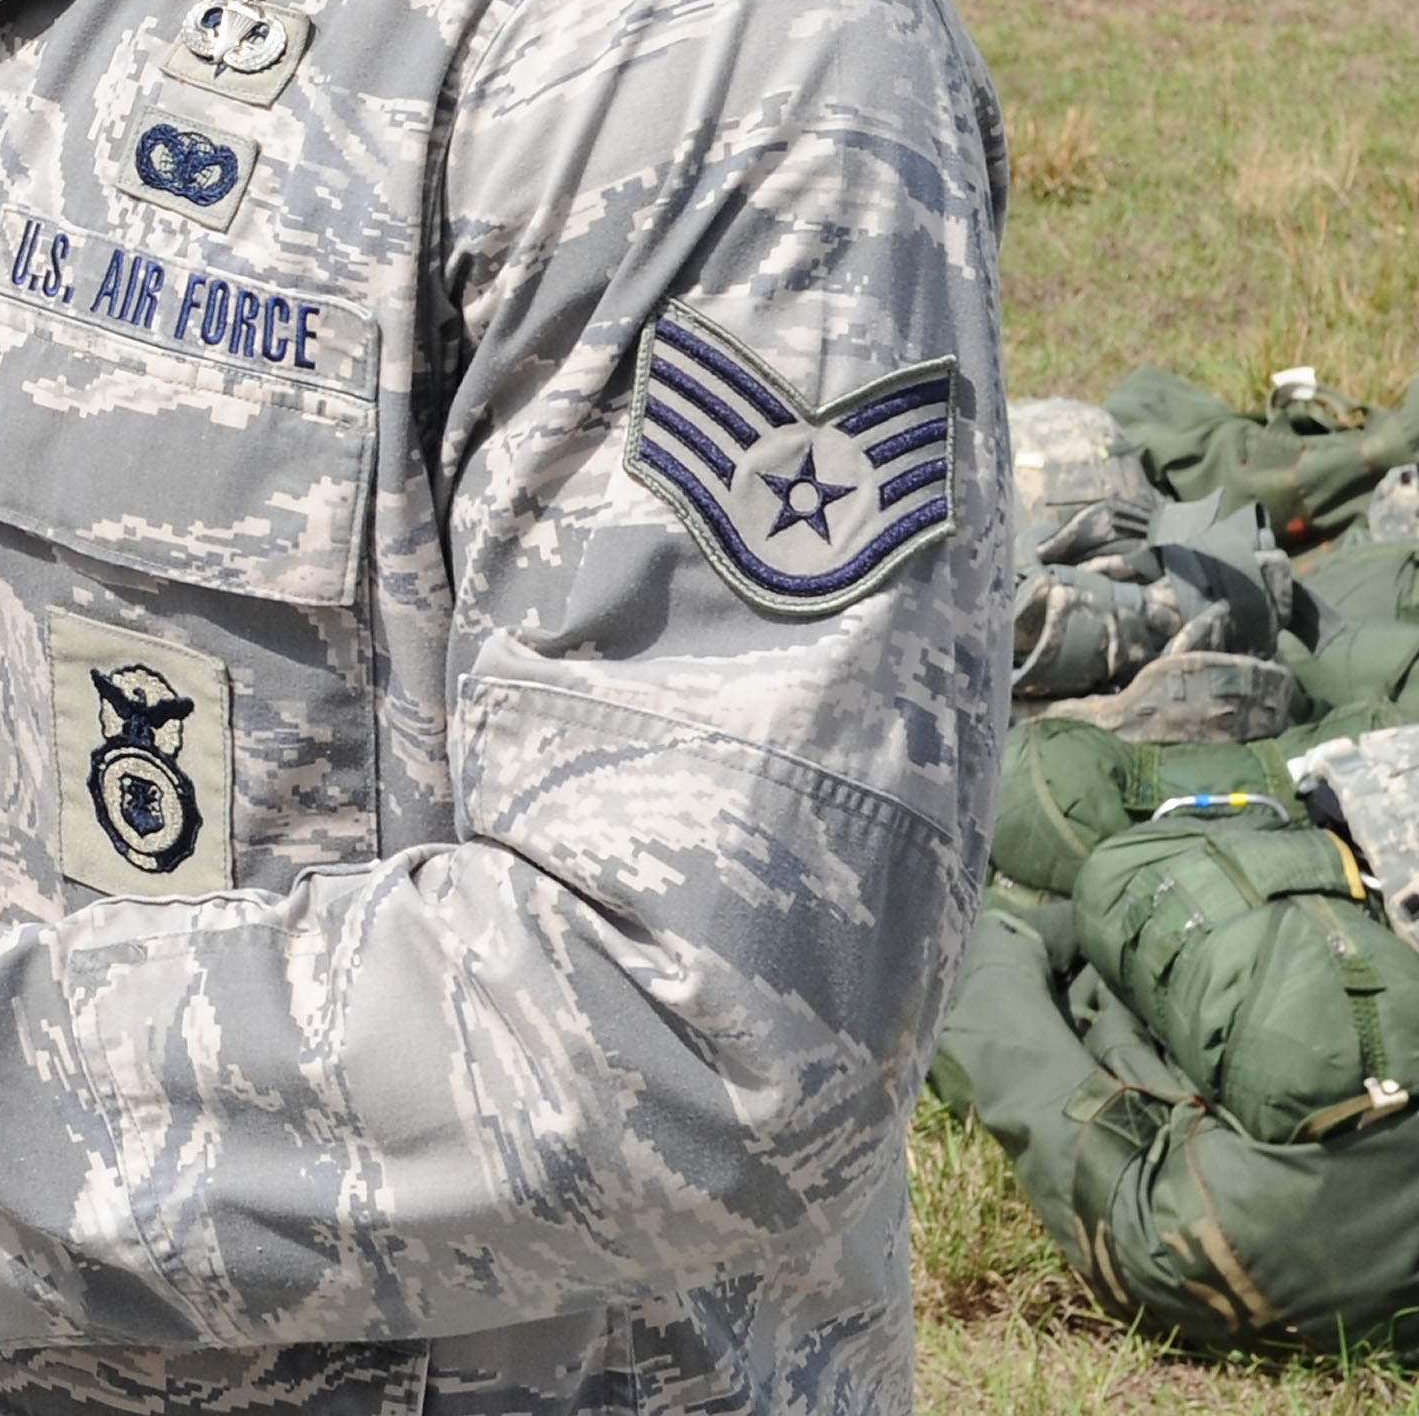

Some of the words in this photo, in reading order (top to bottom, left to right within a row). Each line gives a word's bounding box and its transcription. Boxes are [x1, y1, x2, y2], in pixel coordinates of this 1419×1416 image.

[12, 220, 75, 304] U.S.
[90, 249, 165, 329] AIR
[174, 272, 320, 370] FORCE
